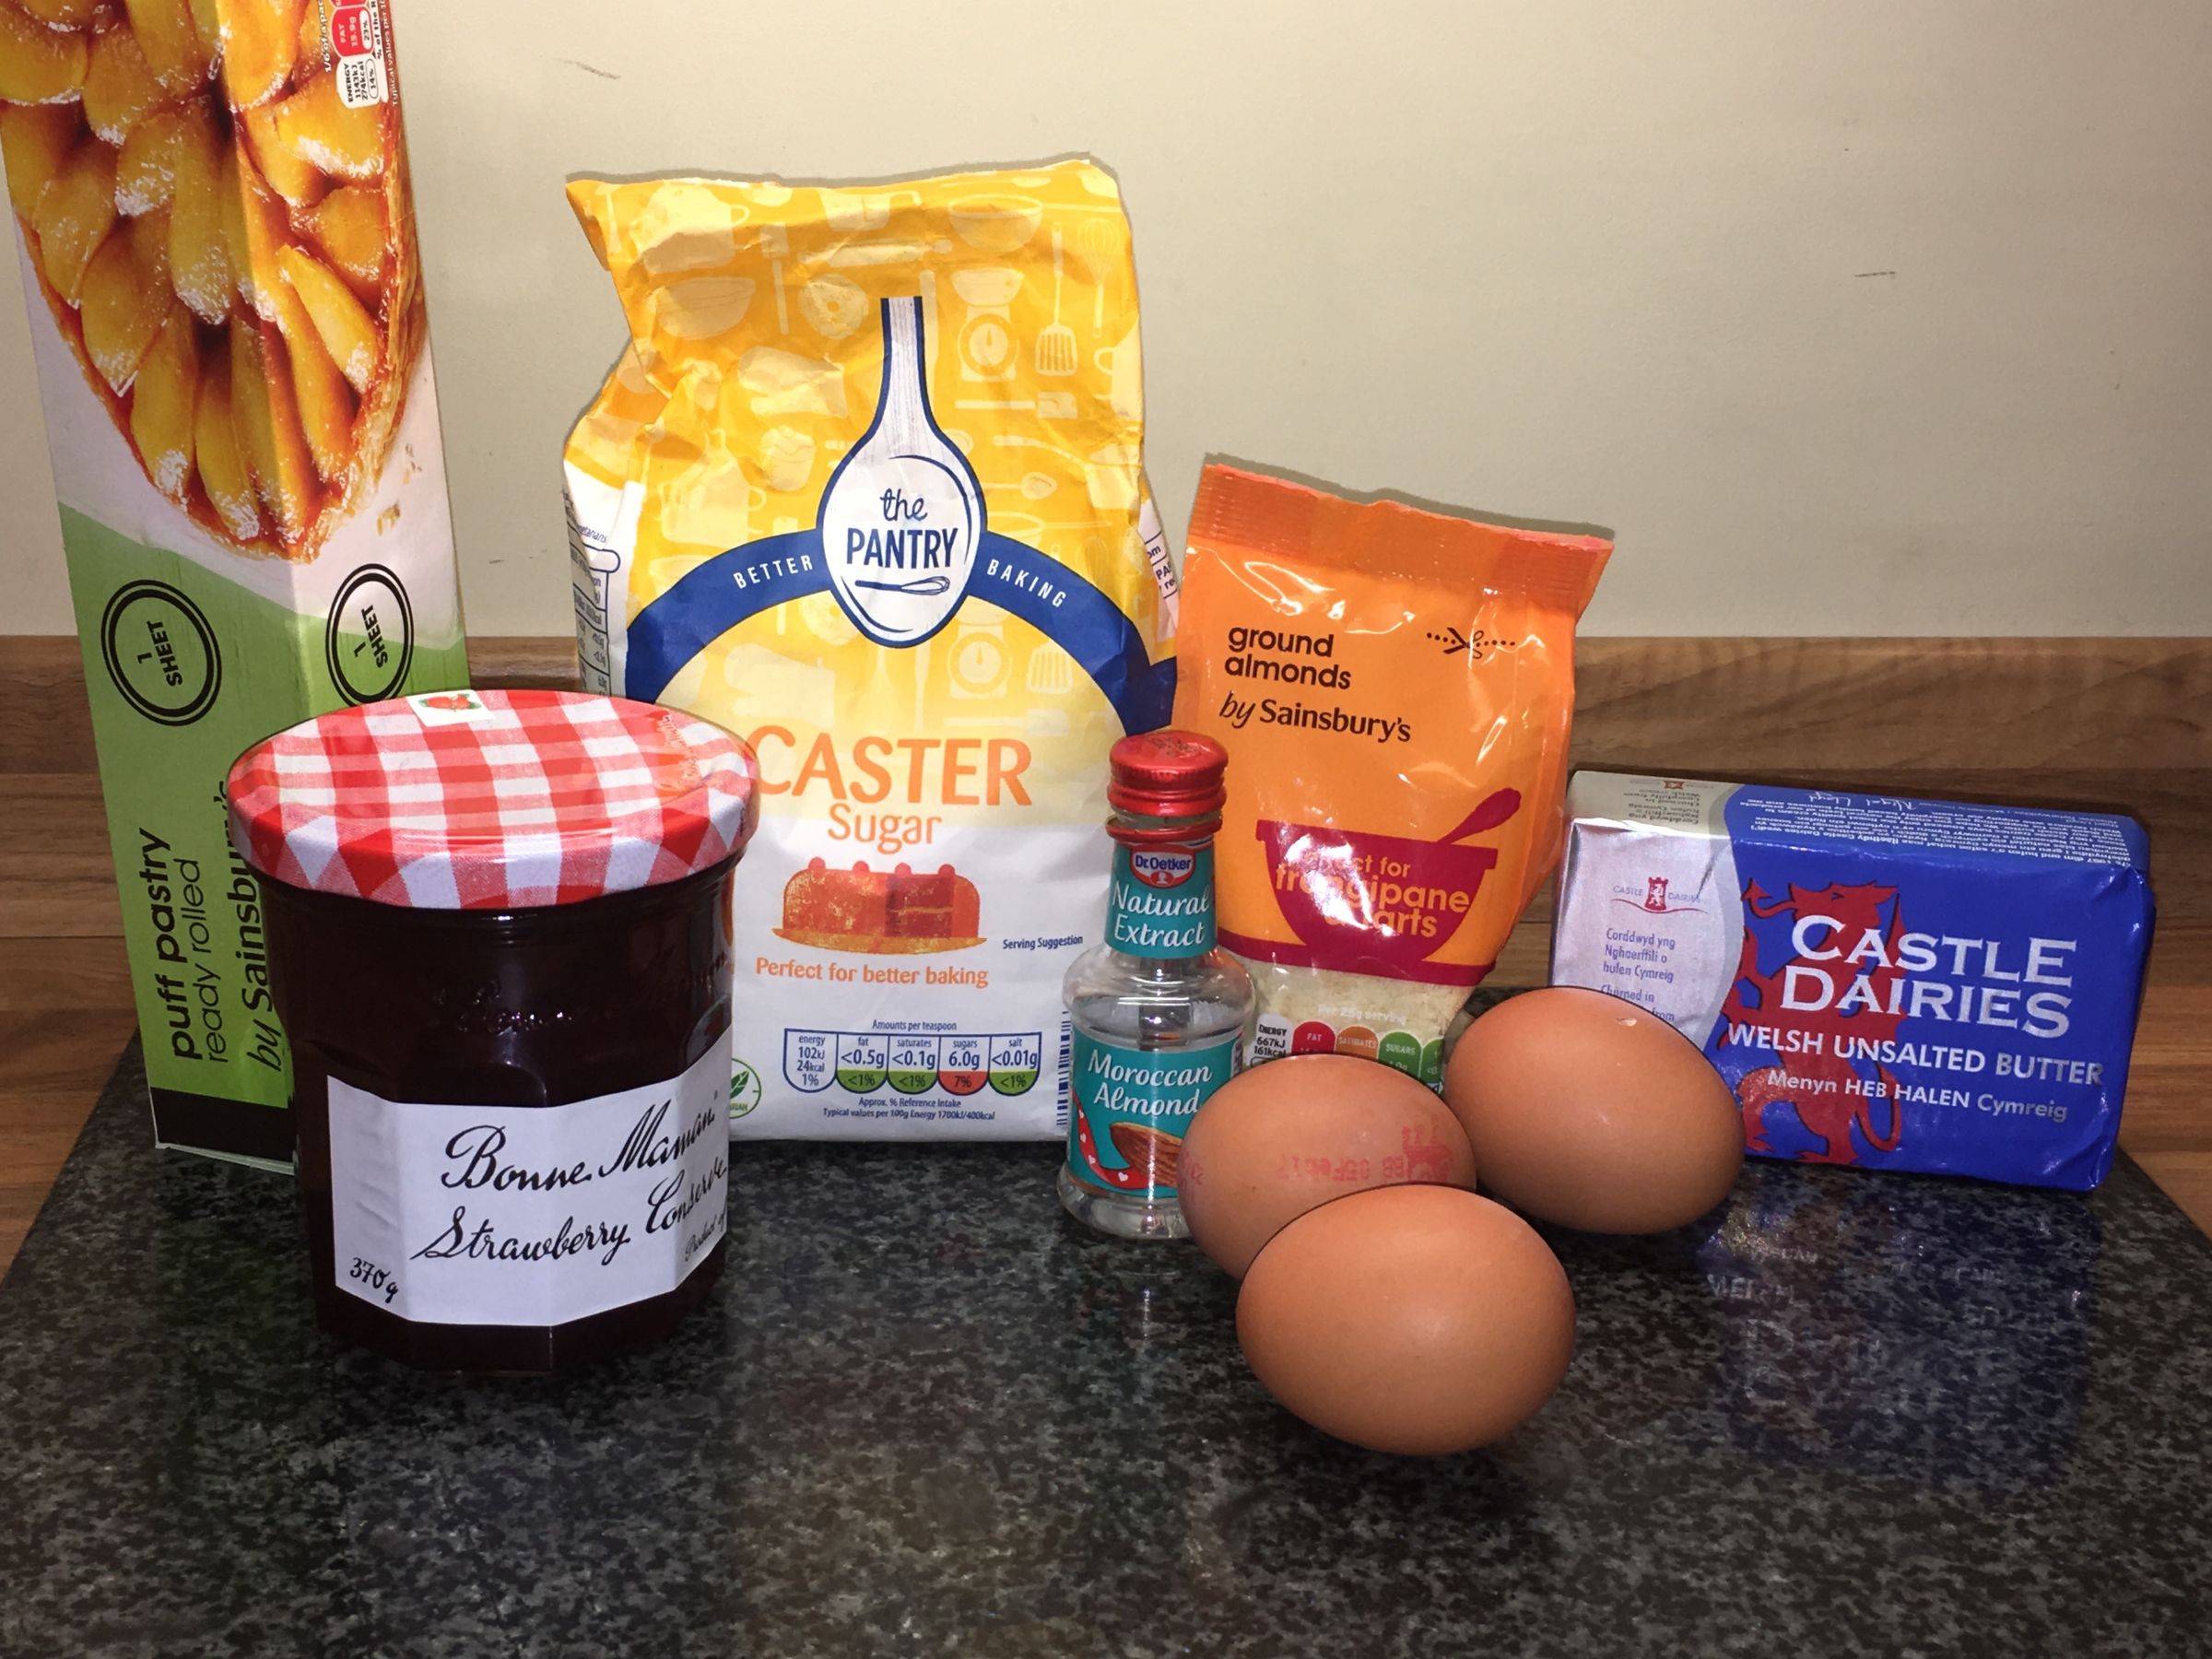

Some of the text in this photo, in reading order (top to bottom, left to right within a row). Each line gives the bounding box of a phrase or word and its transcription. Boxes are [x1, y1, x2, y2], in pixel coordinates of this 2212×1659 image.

[338, 23, 347, 43] FAT
[348, 16, 359, 47] 15.9g
[362, 20, 371, 41] 23%
[344, 63, 354, 102] ENERGY
[357, 61, 368, 100] 274kcal
[369, 68, 377, 89] 14%
[880, 488, 928, 523] the
[846, 527, 959, 570] PANTRY
[733, 554, 1068, 608] BETTER BAKING
[146, 618, 183, 688] SHEET
[360, 604, 388, 669] SHEET
[1228, 627, 1335, 658] ground
[1224, 653, 1352, 690] almonds
[1218, 690, 1412, 744] by Sainsbury's
[748, 724, 1032, 806] CASTER
[827, 802, 943, 855] Sugar
[1381, 856, 1411, 878] for
[1111, 880, 1210, 917] Natural
[1113, 913, 1206, 948] Extract
[1365, 905, 1438, 938] arts
[1606, 927, 1676, 950] Corddwyd yng
[139, 827, 204, 1061] puff pastry
[1002, 934, 1084, 951] Serving Suggestion
[1605, 944, 1658, 962] Nghaerffili
[1791, 914, 2077, 988] CASTLE
[173, 857, 229, 1064] ready rolled
[756, 957, 989, 989] Perfect for better baking
[1603, 960, 1675, 983] hufen Cymreig
[1644, 990, 1655, 1003] in
[1780, 965, 2073, 1039] DAIRIES
[872, 1018, 957, 1031] Amounts per teaspoon
[1259, 1024, 1288, 1037] ENERGY
[1306, 1032, 1323, 1041] FAT
[1385, 1042, 1417, 1055] SUGARS
[246, 1018, 282, 1072] by
[798, 1034, 1023, 1050] energy fat saturates sugars salt
[798, 1046, 1038, 1070] 102kJ <0.5g <0.1g 6.0g <0.01g
[1253, 1045, 1287, 1057] 161kcal
[1256, 1036, 1287, 1048] 667kJ
[1728, 1022, 2104, 1087] WELSH UNSALTED BUTTER
[796, 1059, 826, 1073] 24kcal
[802, 1073, 1027, 1088] 1% <1% <1% 7% <1%
[1088, 1048, 1213, 1088] Moroccan
[823, 1107, 850, 1118] Typical
[850, 1108, 876, 1117] values
[876, 1110, 889, 1119] per
[890, 1109, 909, 1119] 100g
[910, 1110, 935, 1120] Energy
[858, 1096, 962, 1108] Approx. % Reference Intake
[1093, 1083, 1200, 1117] Almond
[1767, 1069, 2068, 1124] Menyn HEB HALEN Cymreig
[441, 1124, 593, 1191] Bonne
[408, 1156, 727, 1266] Strawberry Conserve
